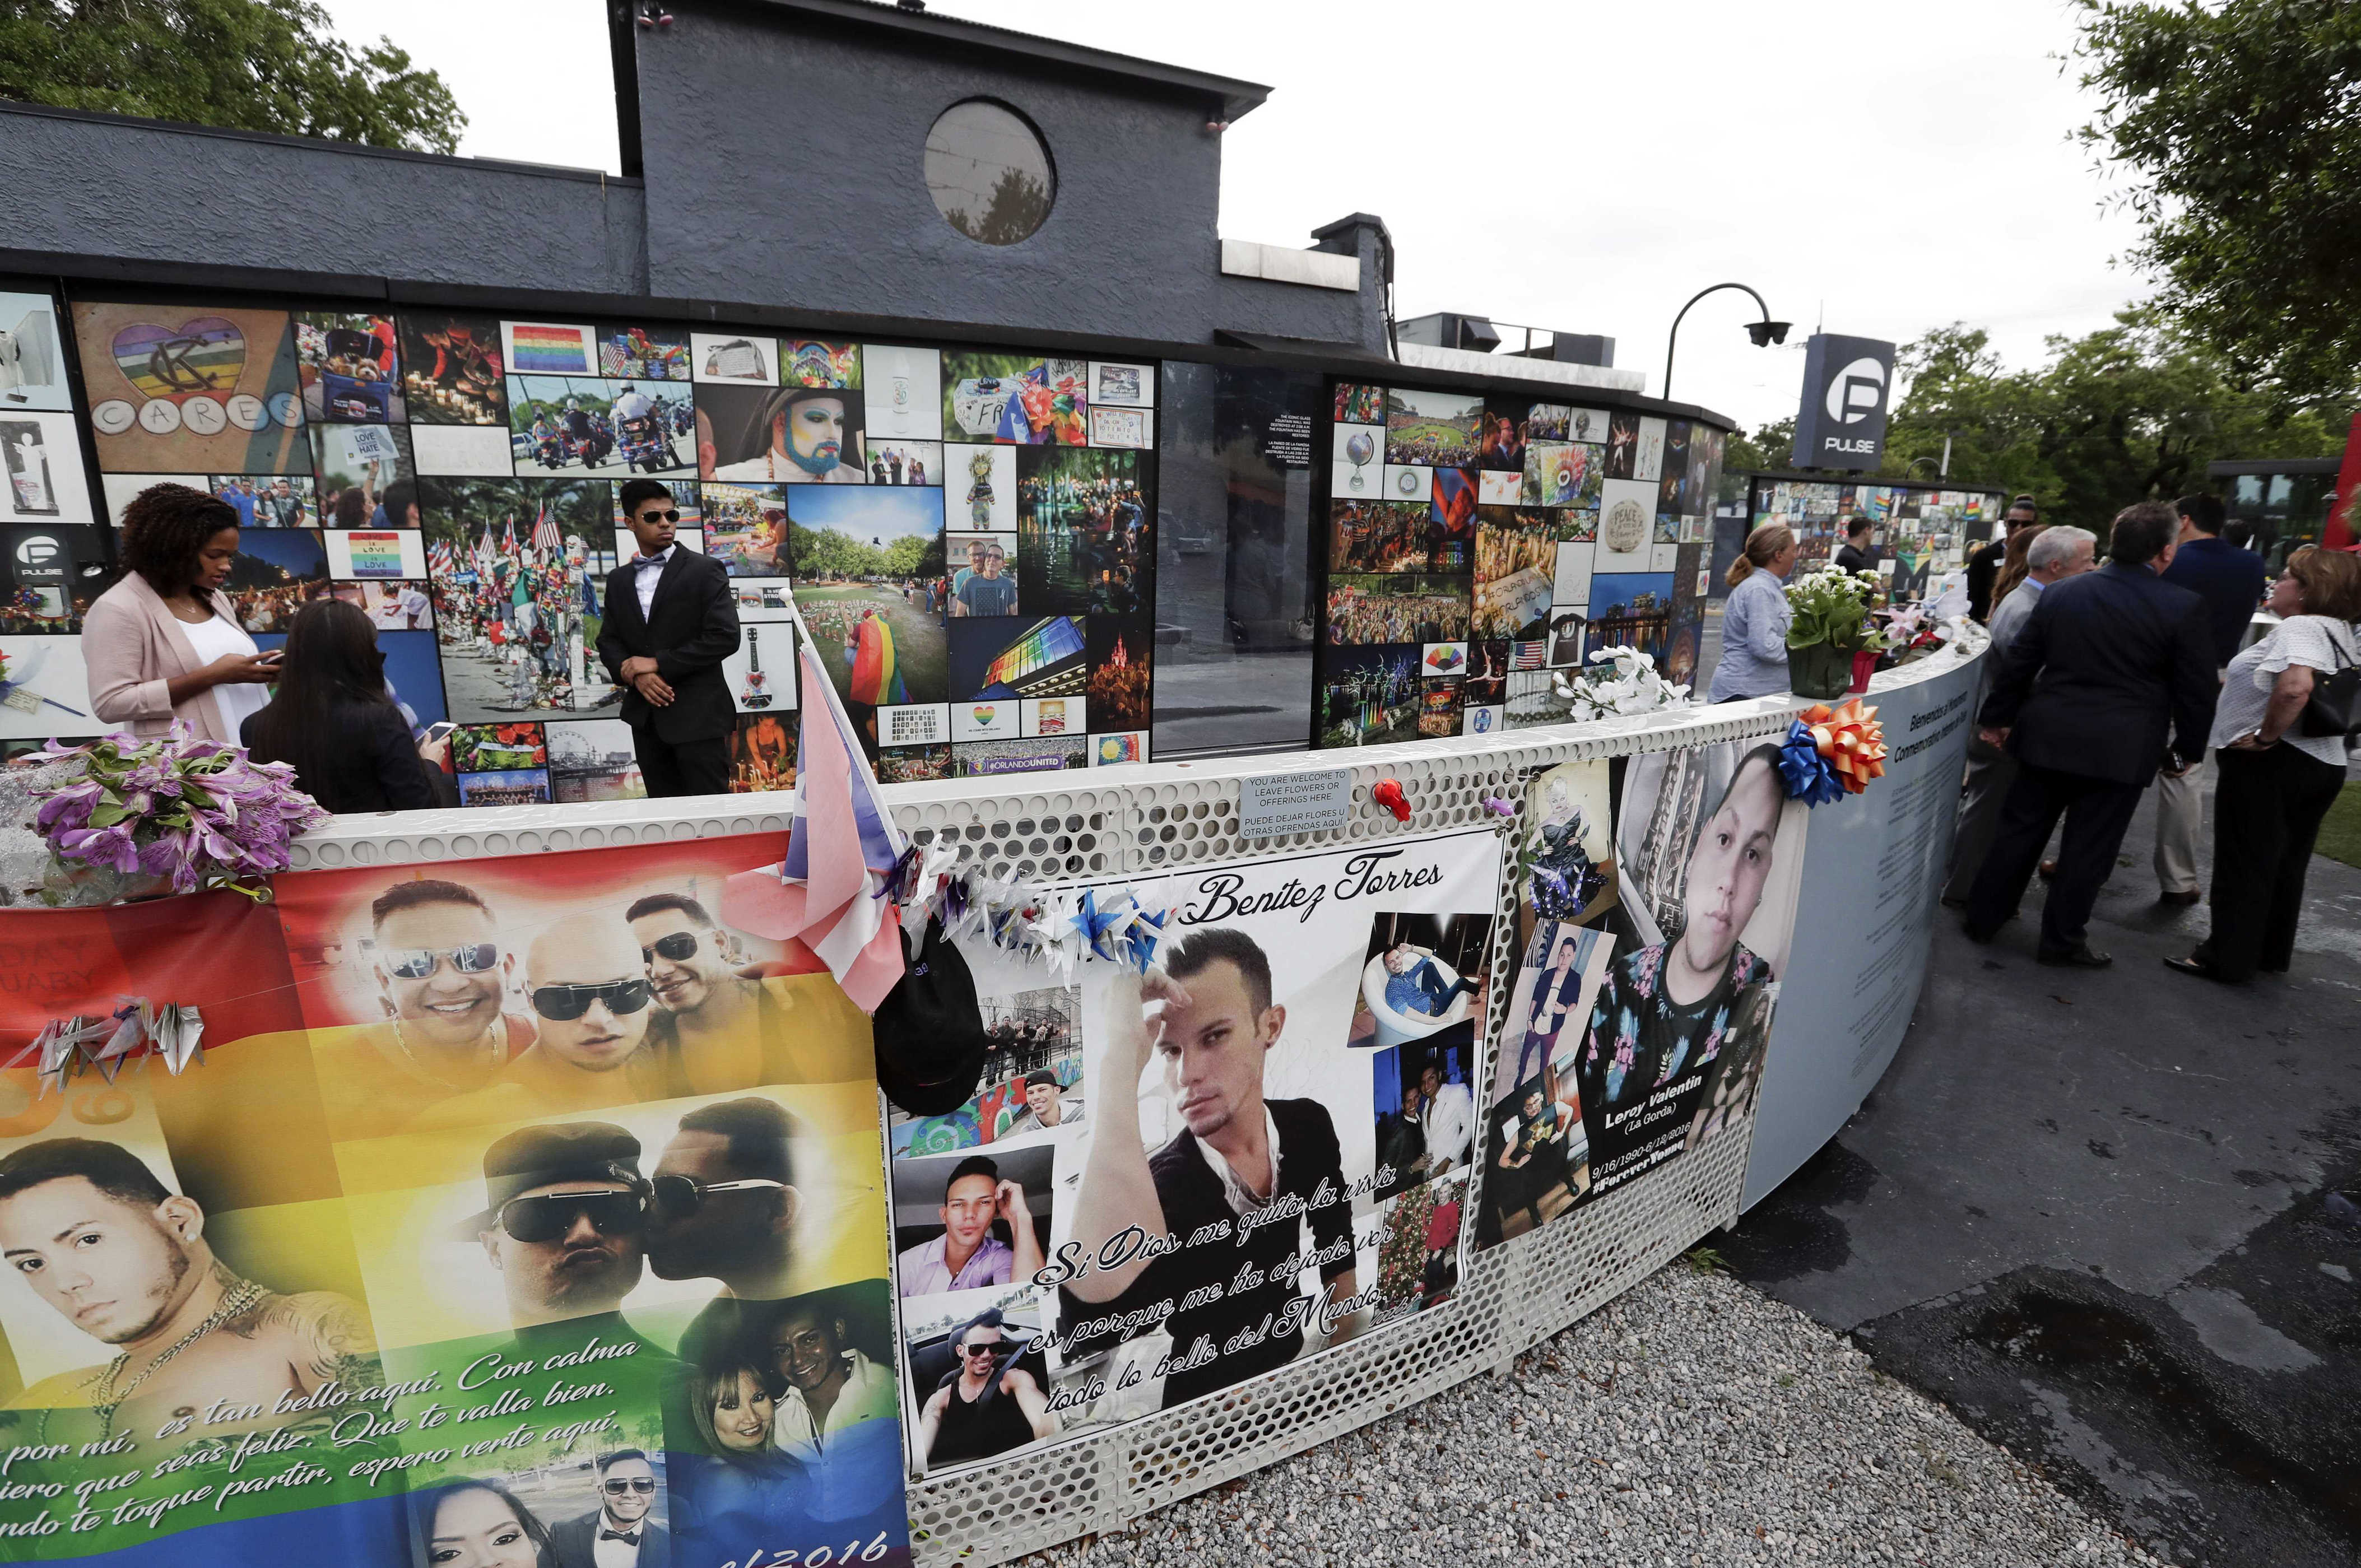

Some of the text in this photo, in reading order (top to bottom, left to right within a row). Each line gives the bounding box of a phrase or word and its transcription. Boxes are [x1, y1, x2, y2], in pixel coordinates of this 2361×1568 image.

[102, 400, 296, 424] CARES
[355, 432, 376, 443] LOVE
[359, 444, 380, 454] HATE
[1825, 437, 1875, 454] PULSE
[989, 758, 1058, 770] #ORLANDOUNITED
[1290, 772, 1332, 783] WELCOME
[1255, 787, 1282, 797] LEAVE
[1285, 783, 1325, 794] FLOWERS
[1259, 793, 1333, 807] OFFERINGS HERE.
[1244, 817, 1344, 836] OTRAS OFRENDAS AQUÍ.
[1245, 816, 1273, 826] PUEDE
[1276, 813, 1303, 822] DEJAR
[1305, 809, 1337, 820] FLORES
[1178, 849, 1444, 923] Benitez Torres
[1605, 1075, 1702, 1129] Leroy Valentin
[1625, 1102, 1676, 1135] (La Gorda)
[1592, 1122, 1691, 1179] 9/16/1990-6/12/2016
[1032, 1162, 1397, 1287] Si Dios me quita la vista
[1026, 1225, 1396, 1355] es porque me ha dejado ver
[1043, 1374, 1107, 1416] todo
[1115, 1357, 1142, 1392] lo
[1151, 1336, 1219, 1382] bello
[1223, 1314, 1273, 1356] del
[2, 1337, 640, 1476] por mí, es tan bello aquí. Con calma
[73, 1469, 144, 1509] que
[151, 1445, 233, 1480] seas
[229, 1427, 312, 1473] feliz.
[331, 1411, 412, 1446] Que
[419, 1403, 450, 1429] te
[457, 1379, 536, 1423] valla
[542, 1378, 615, 1408] bien.
[0, 1409, 619, 1537] ndo te toque partir, espero verte aquí.
